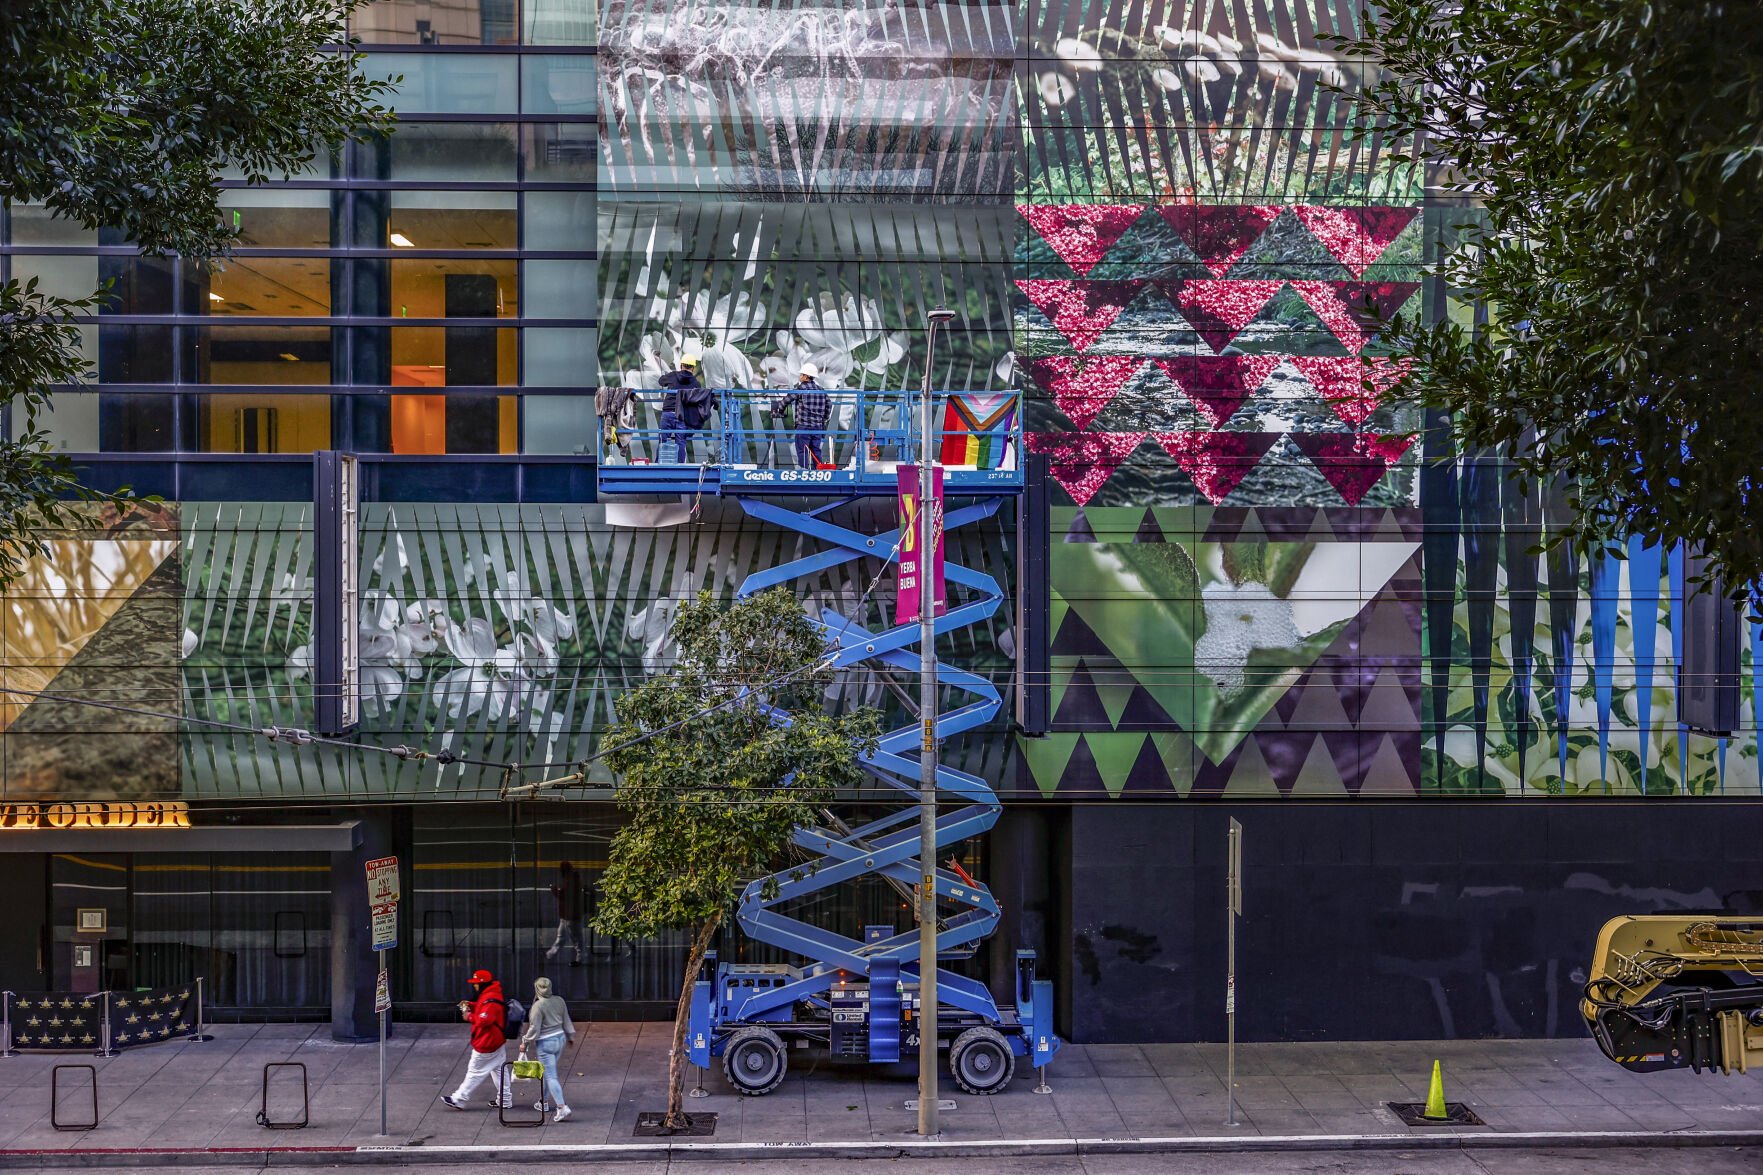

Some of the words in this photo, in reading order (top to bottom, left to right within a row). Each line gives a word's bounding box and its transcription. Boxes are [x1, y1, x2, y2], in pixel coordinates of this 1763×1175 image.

[743, 471, 774, 481] Genie
[780, 471, 832, 481] GS-5390
[899, 560, 916, 574] YERBA
[900, 576, 916, 590] BUENA
[47, 802, 191, 828] ORDER
[369, 859, 394, 868] TOW-AWAY
[368, 869, 376, 879] NO
[379, 877, 390, 886] ANY
